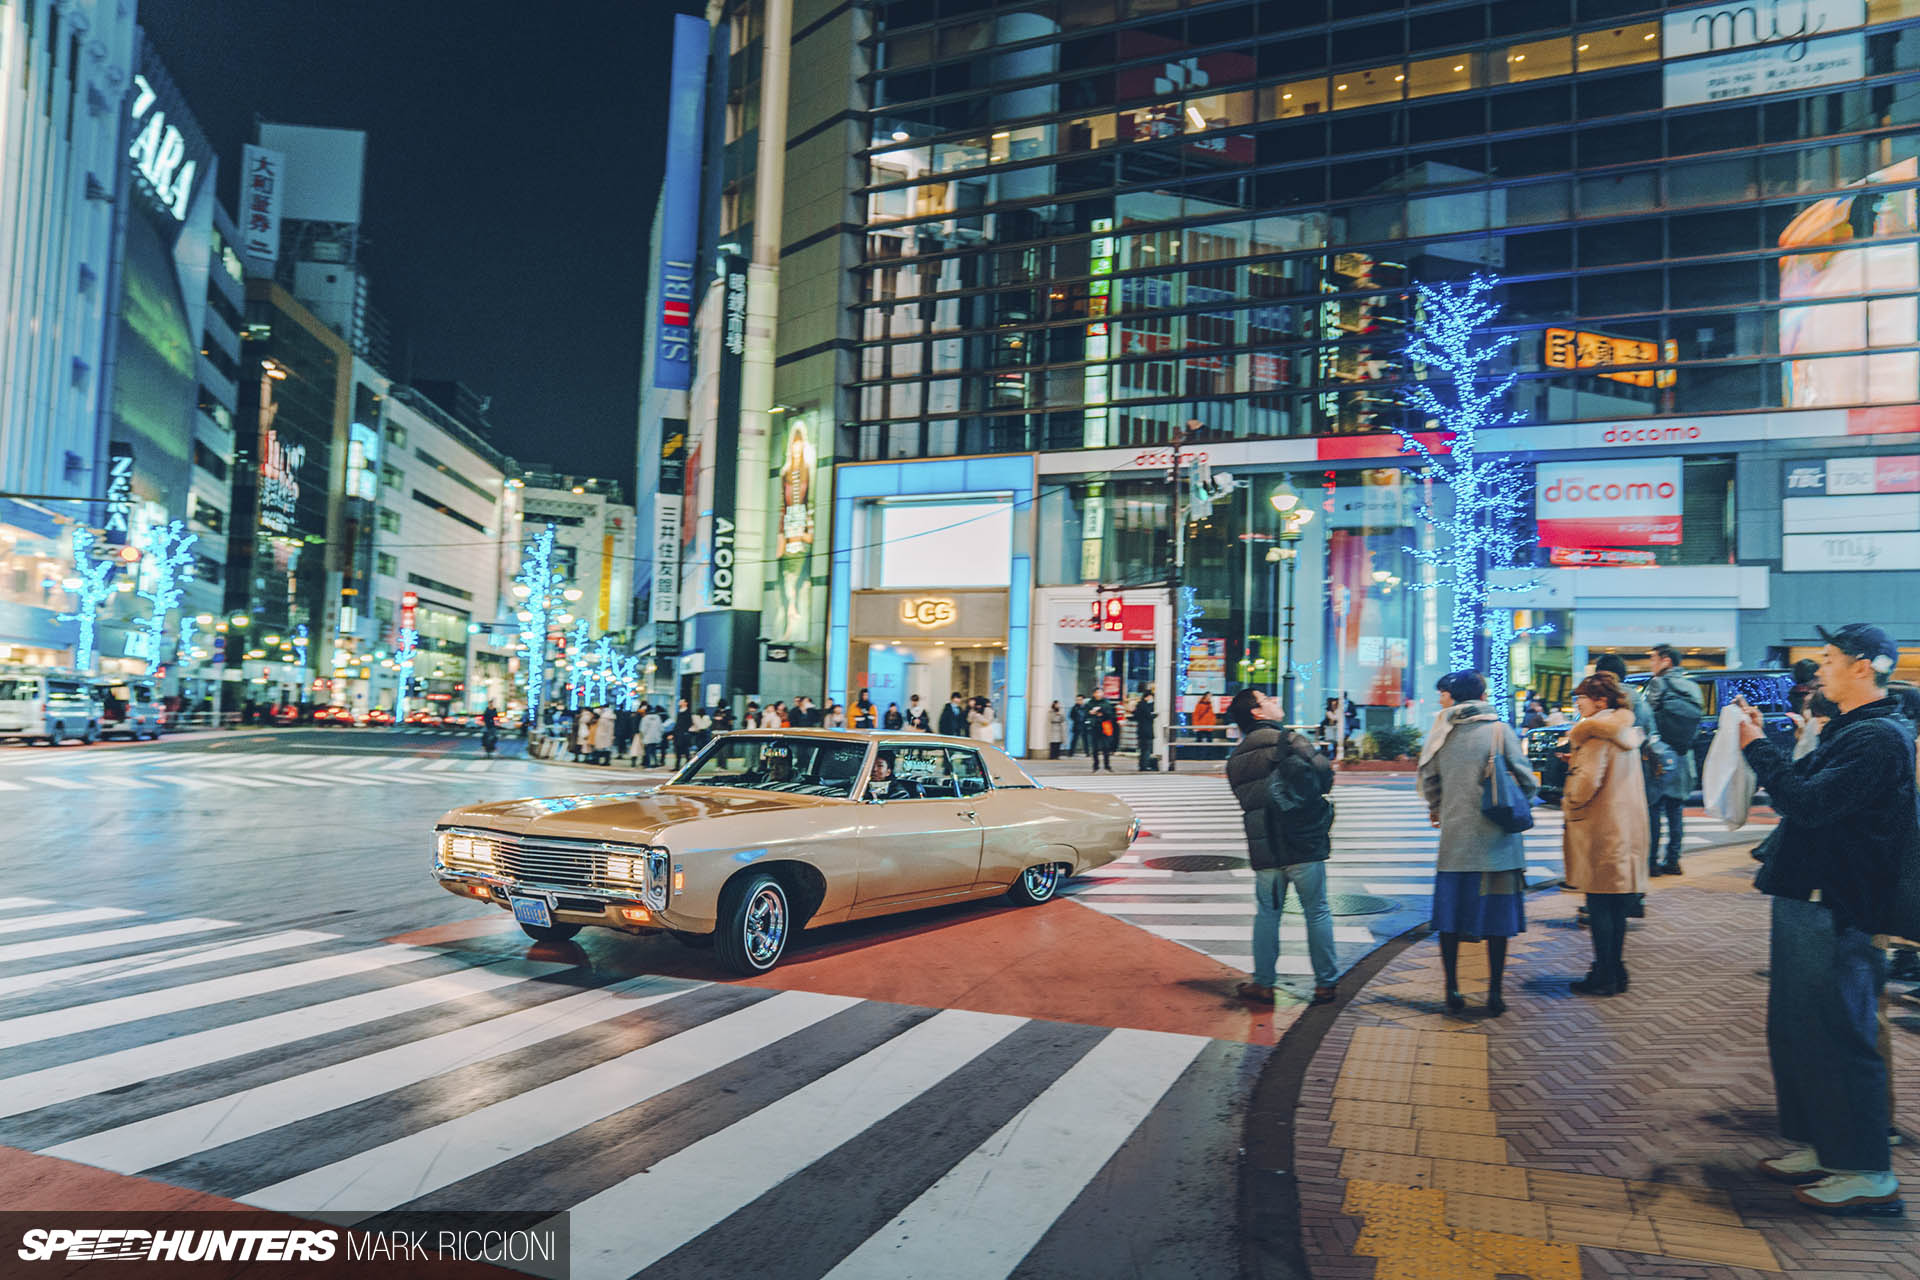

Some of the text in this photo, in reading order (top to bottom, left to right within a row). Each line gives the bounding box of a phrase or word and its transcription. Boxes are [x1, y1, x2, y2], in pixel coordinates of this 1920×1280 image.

[129, 74, 196, 221] ZARA
[662, 260, 692, 362] SEIBU
[1603, 424, 1701, 443] docomo
[1544, 478, 1676, 503] docomo
[713, 517, 734, 603] ALOOK
